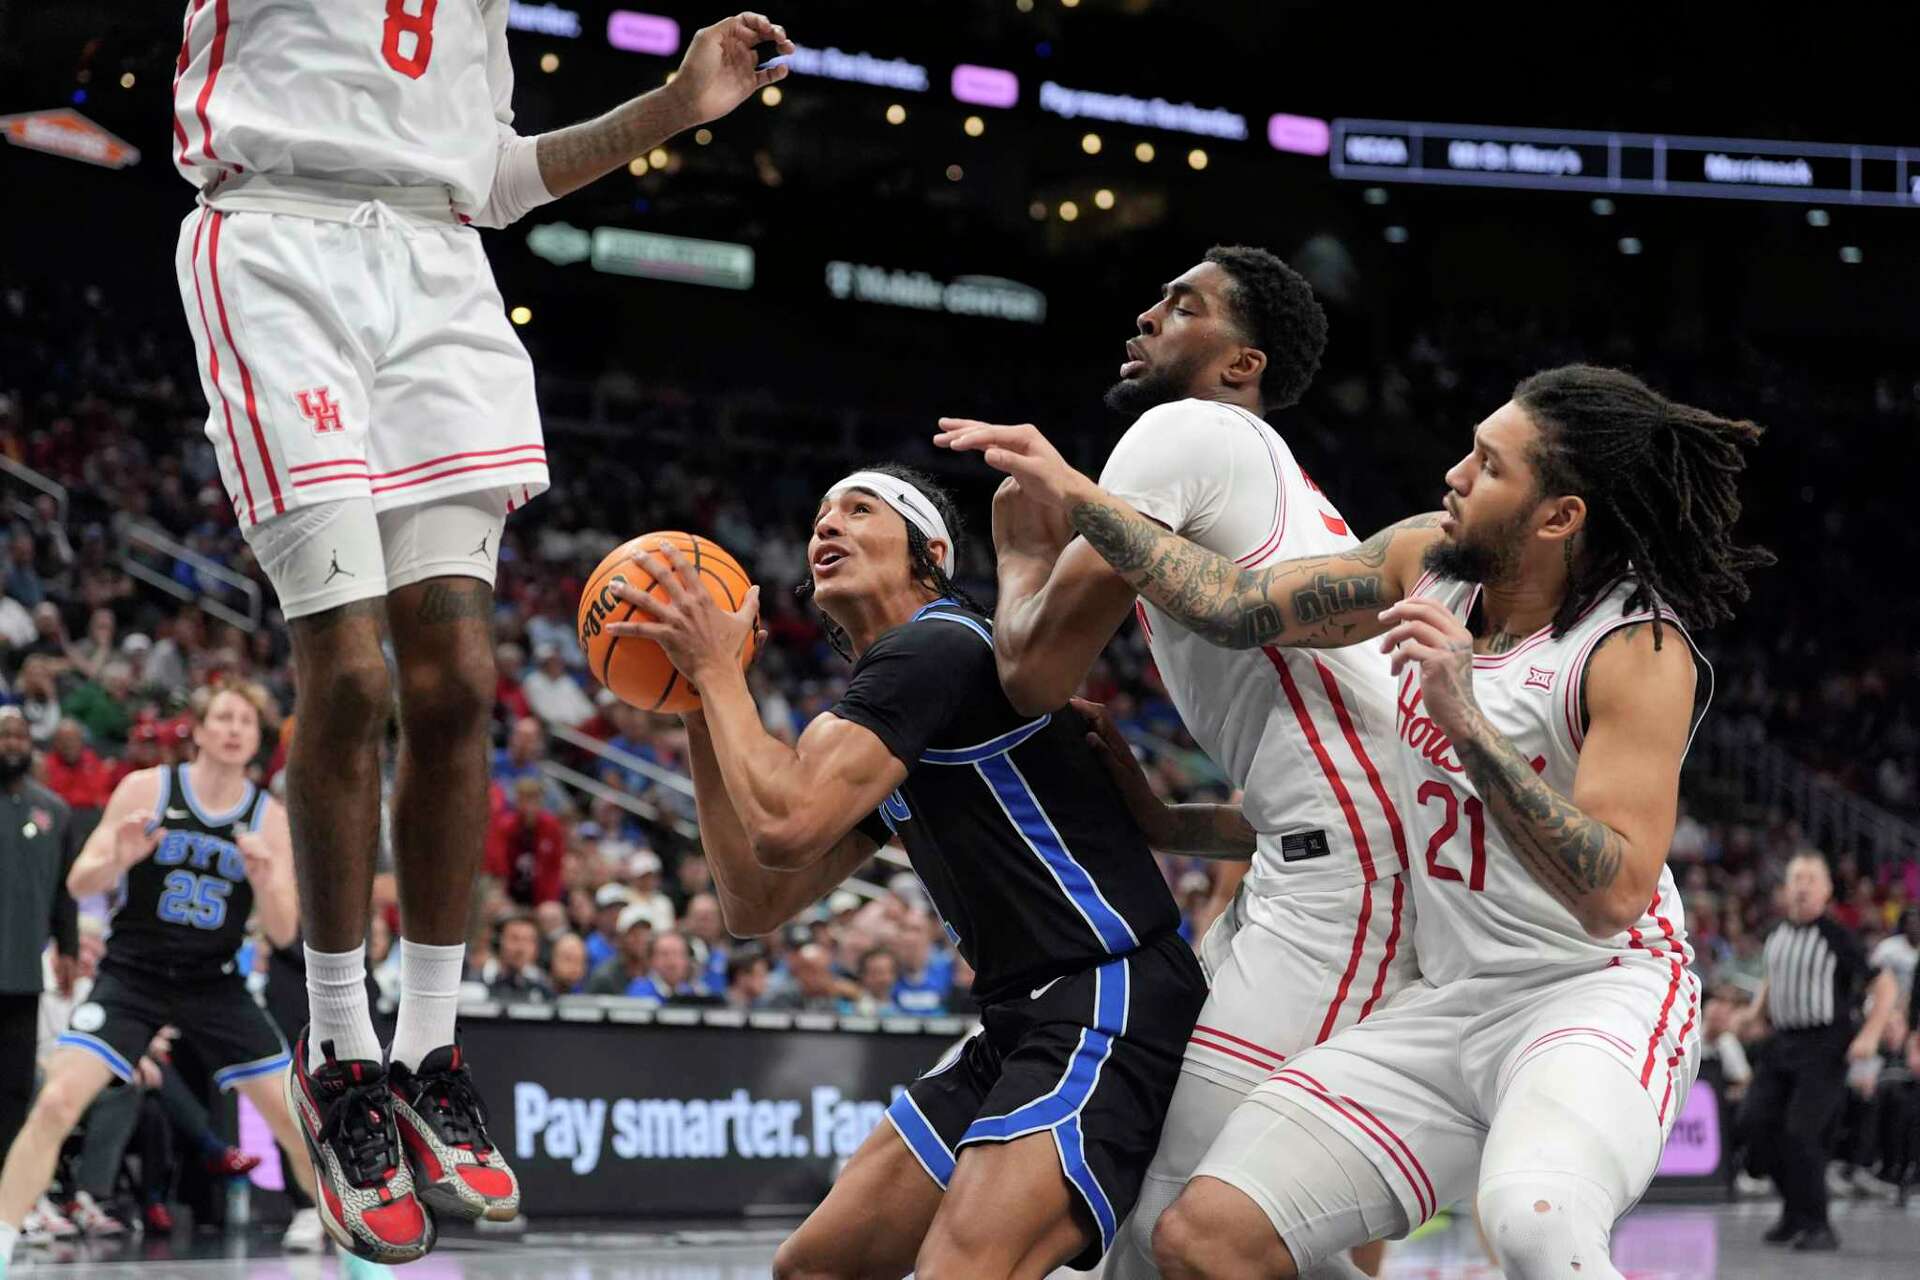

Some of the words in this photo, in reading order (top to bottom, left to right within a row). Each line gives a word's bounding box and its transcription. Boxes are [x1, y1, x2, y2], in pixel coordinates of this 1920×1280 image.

[381, 0, 437, 80] 8
[1417, 779, 1487, 892] 21
[157, 869, 233, 929] 25
[514, 1081, 607, 1175] Pay
[610, 1089, 810, 1159] smarter.
